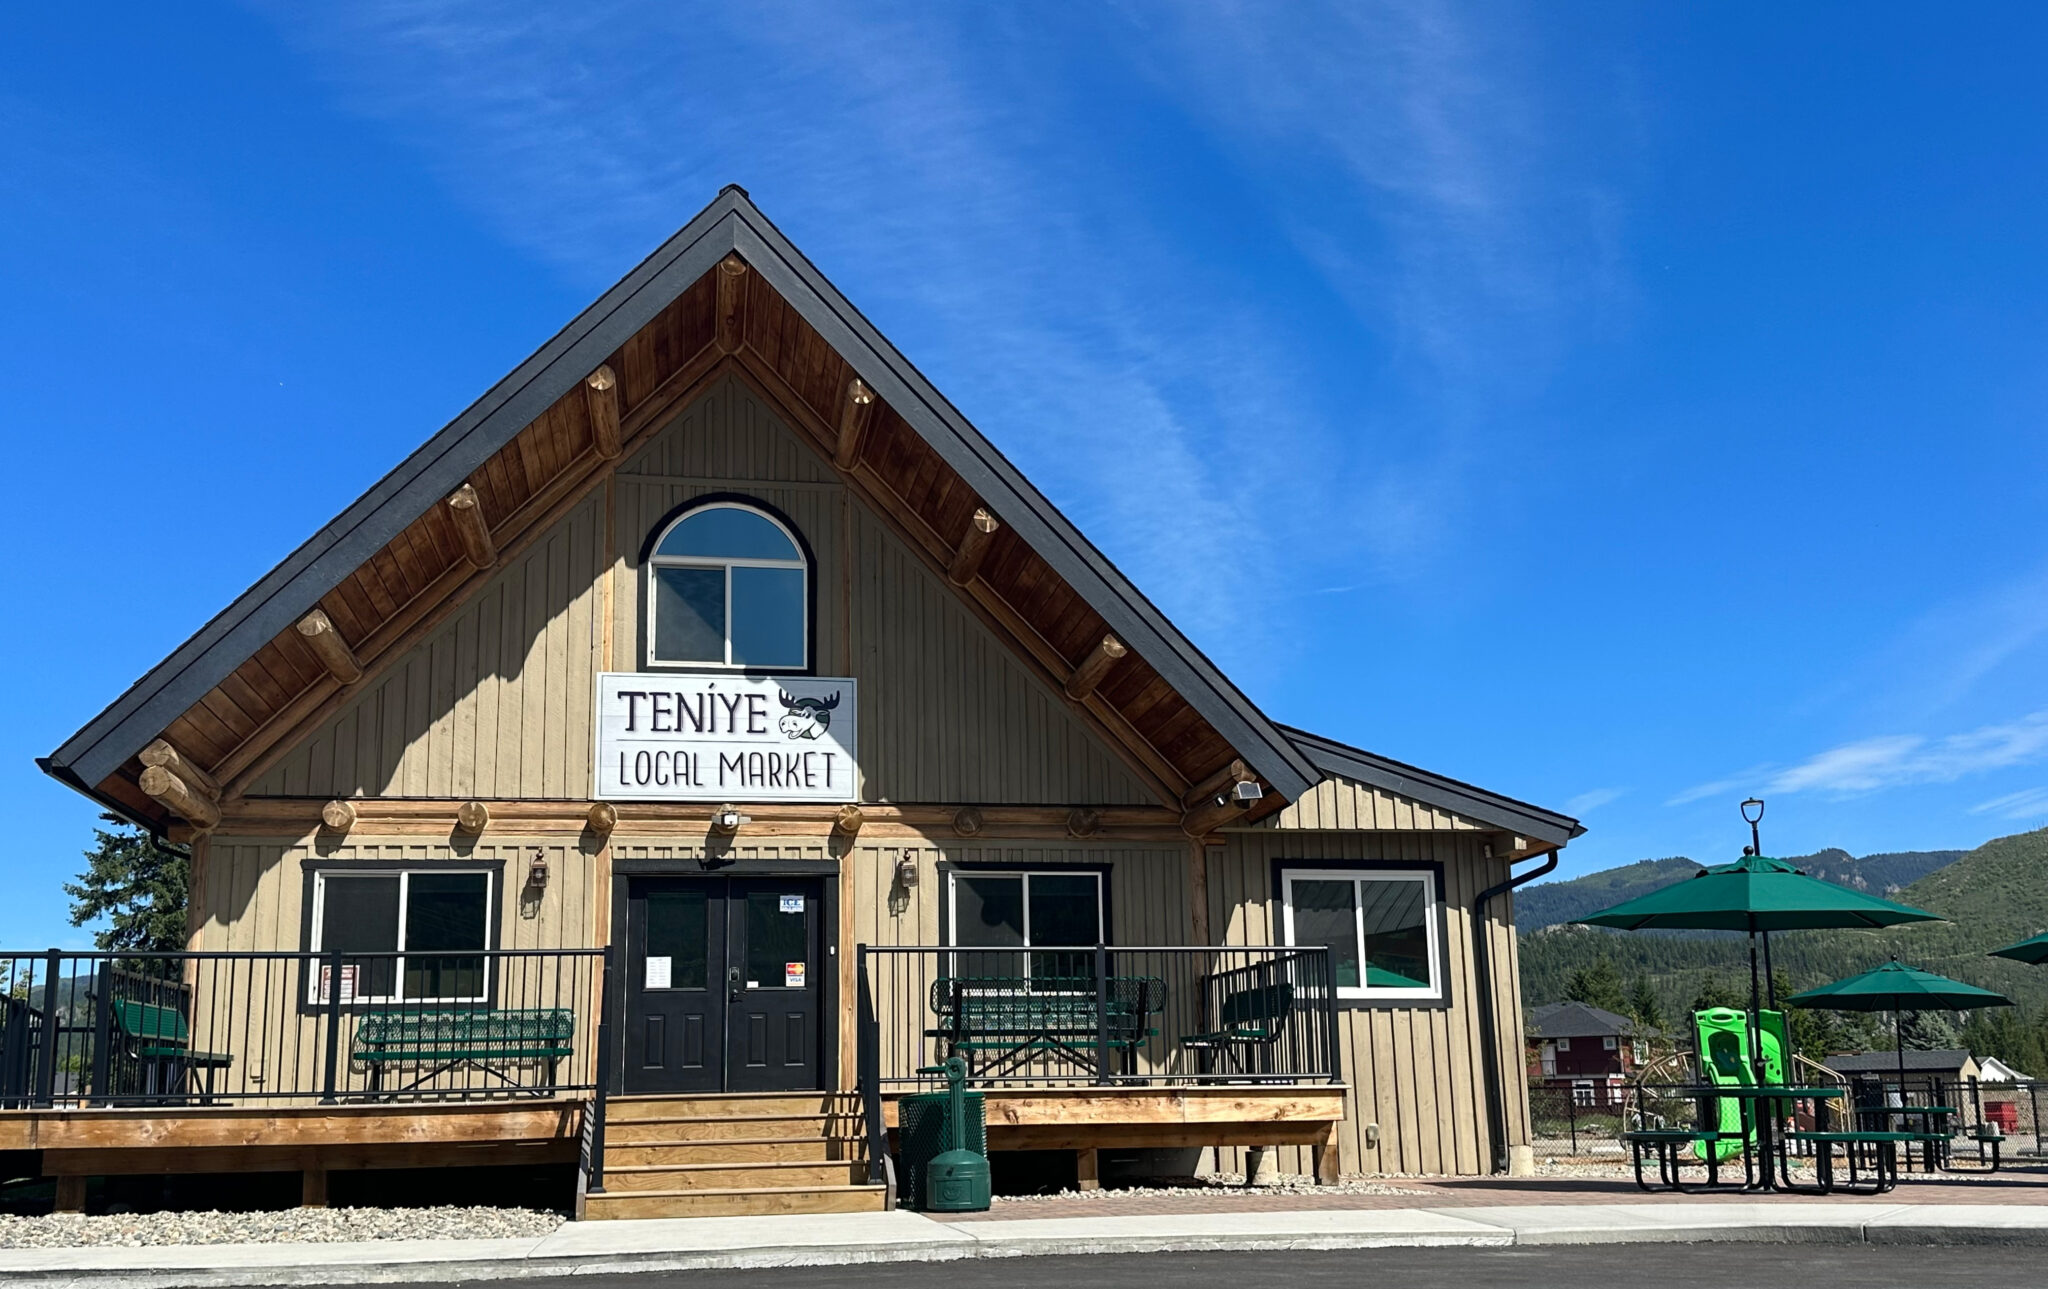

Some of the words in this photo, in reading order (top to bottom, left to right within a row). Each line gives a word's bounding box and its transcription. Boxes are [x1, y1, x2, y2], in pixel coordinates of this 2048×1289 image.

[620, 750, 704, 787] LOCAL
[719, 751, 837, 788] MARKET
[783, 898, 801, 906] ICE
